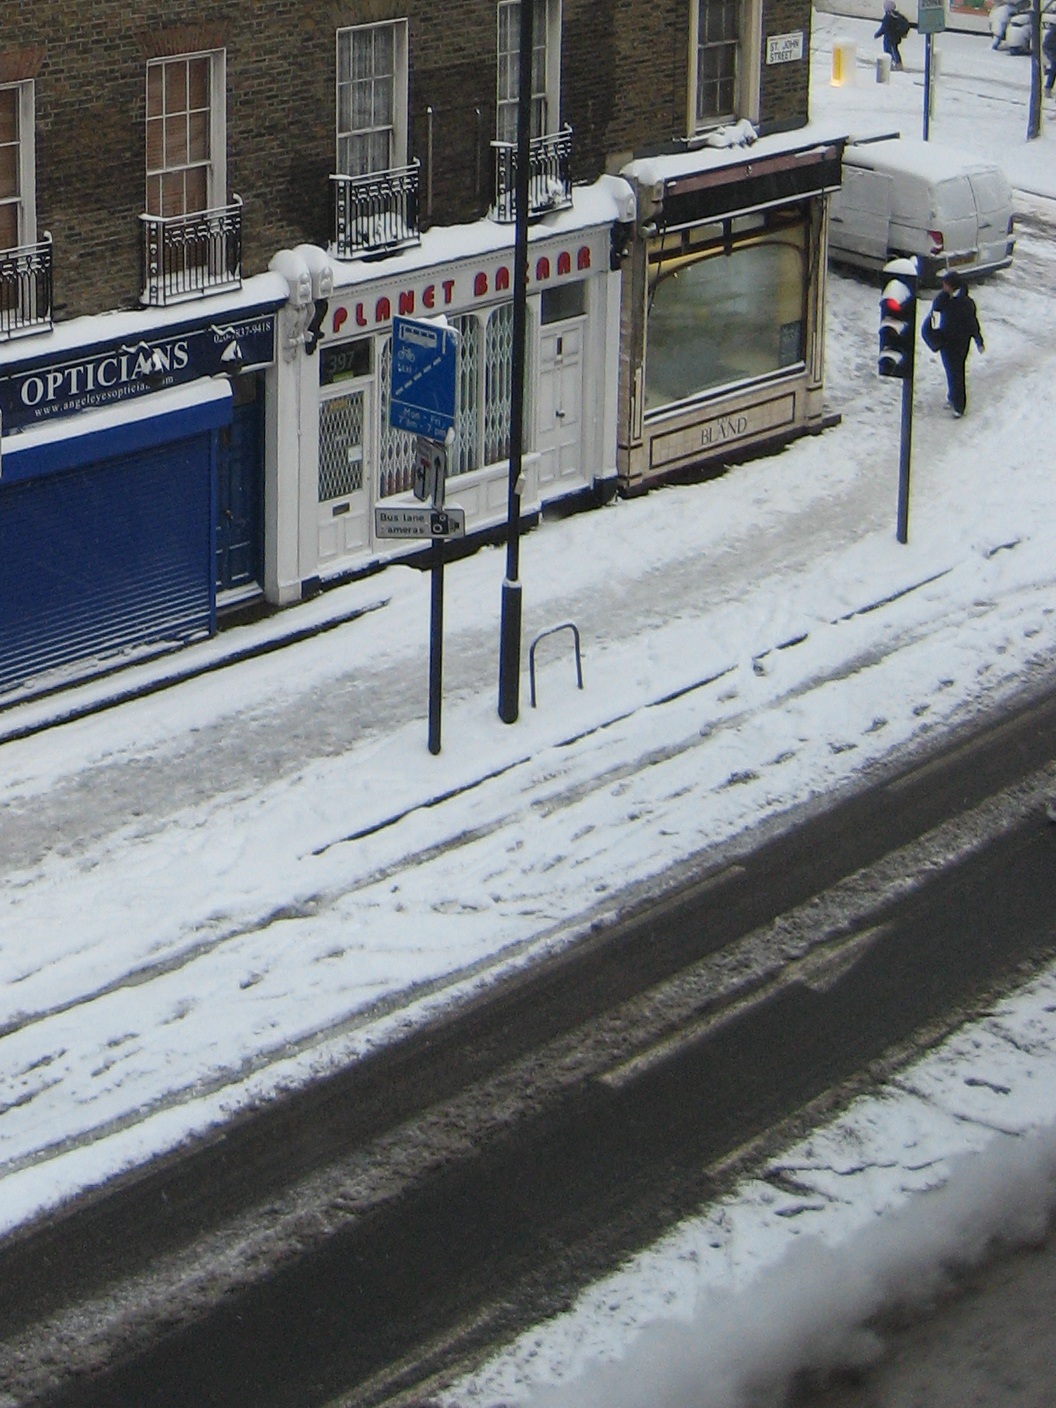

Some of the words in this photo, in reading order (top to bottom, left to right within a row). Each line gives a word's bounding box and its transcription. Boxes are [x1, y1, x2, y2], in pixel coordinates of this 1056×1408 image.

[770, 49, 792, 63] STREET
[332, 279, 455, 333] PLANET
[473, 245, 591, 297] BAAAR
[328, 351, 355, 373] 397
[21, 341, 189, 406] OPTICIANS
[701, 416, 747, 445] BLAND
[380, 513, 399, 522] Bus
[403, 513, 424, 522] lane
[381, 525, 424, 534] ameras
